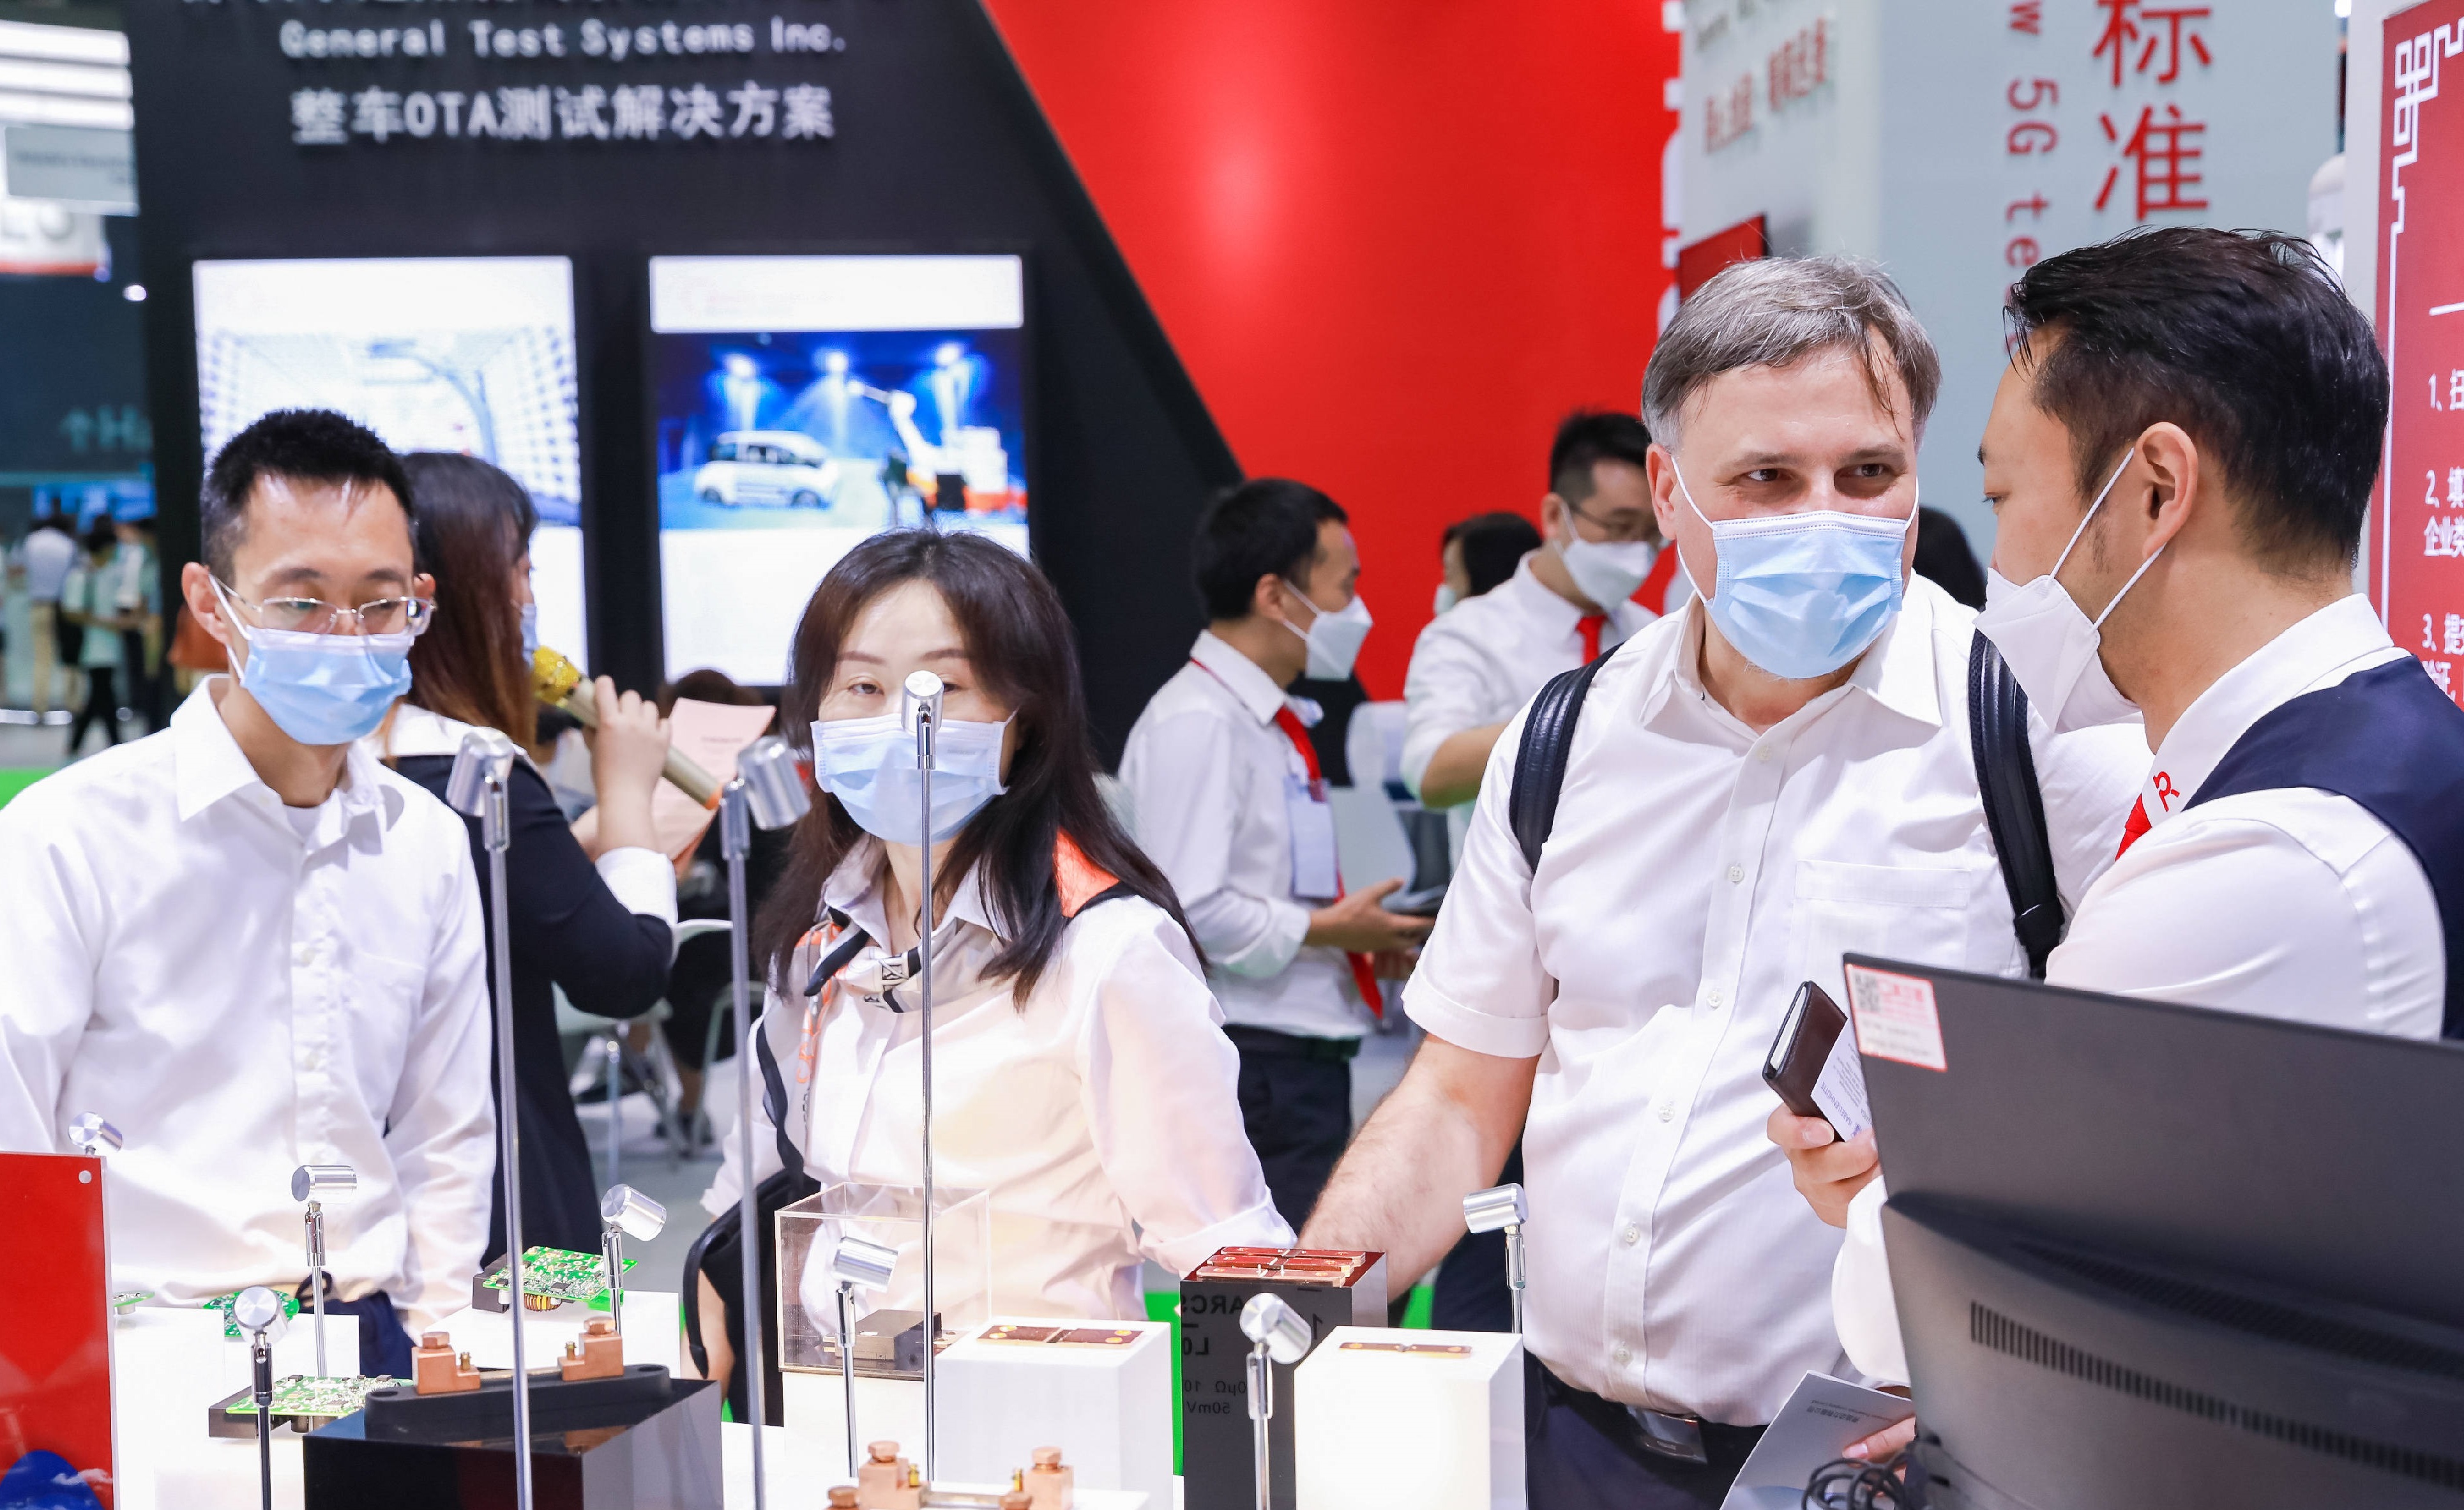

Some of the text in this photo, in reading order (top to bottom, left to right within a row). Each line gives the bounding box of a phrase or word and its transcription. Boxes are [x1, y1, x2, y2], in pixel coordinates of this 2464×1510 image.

[280, 14, 845, 61] General Test Systems Inc.
[291, 80, 833, 144] 整车OTA测试解决方案
[2007, 77, 2060, 155] 5G
